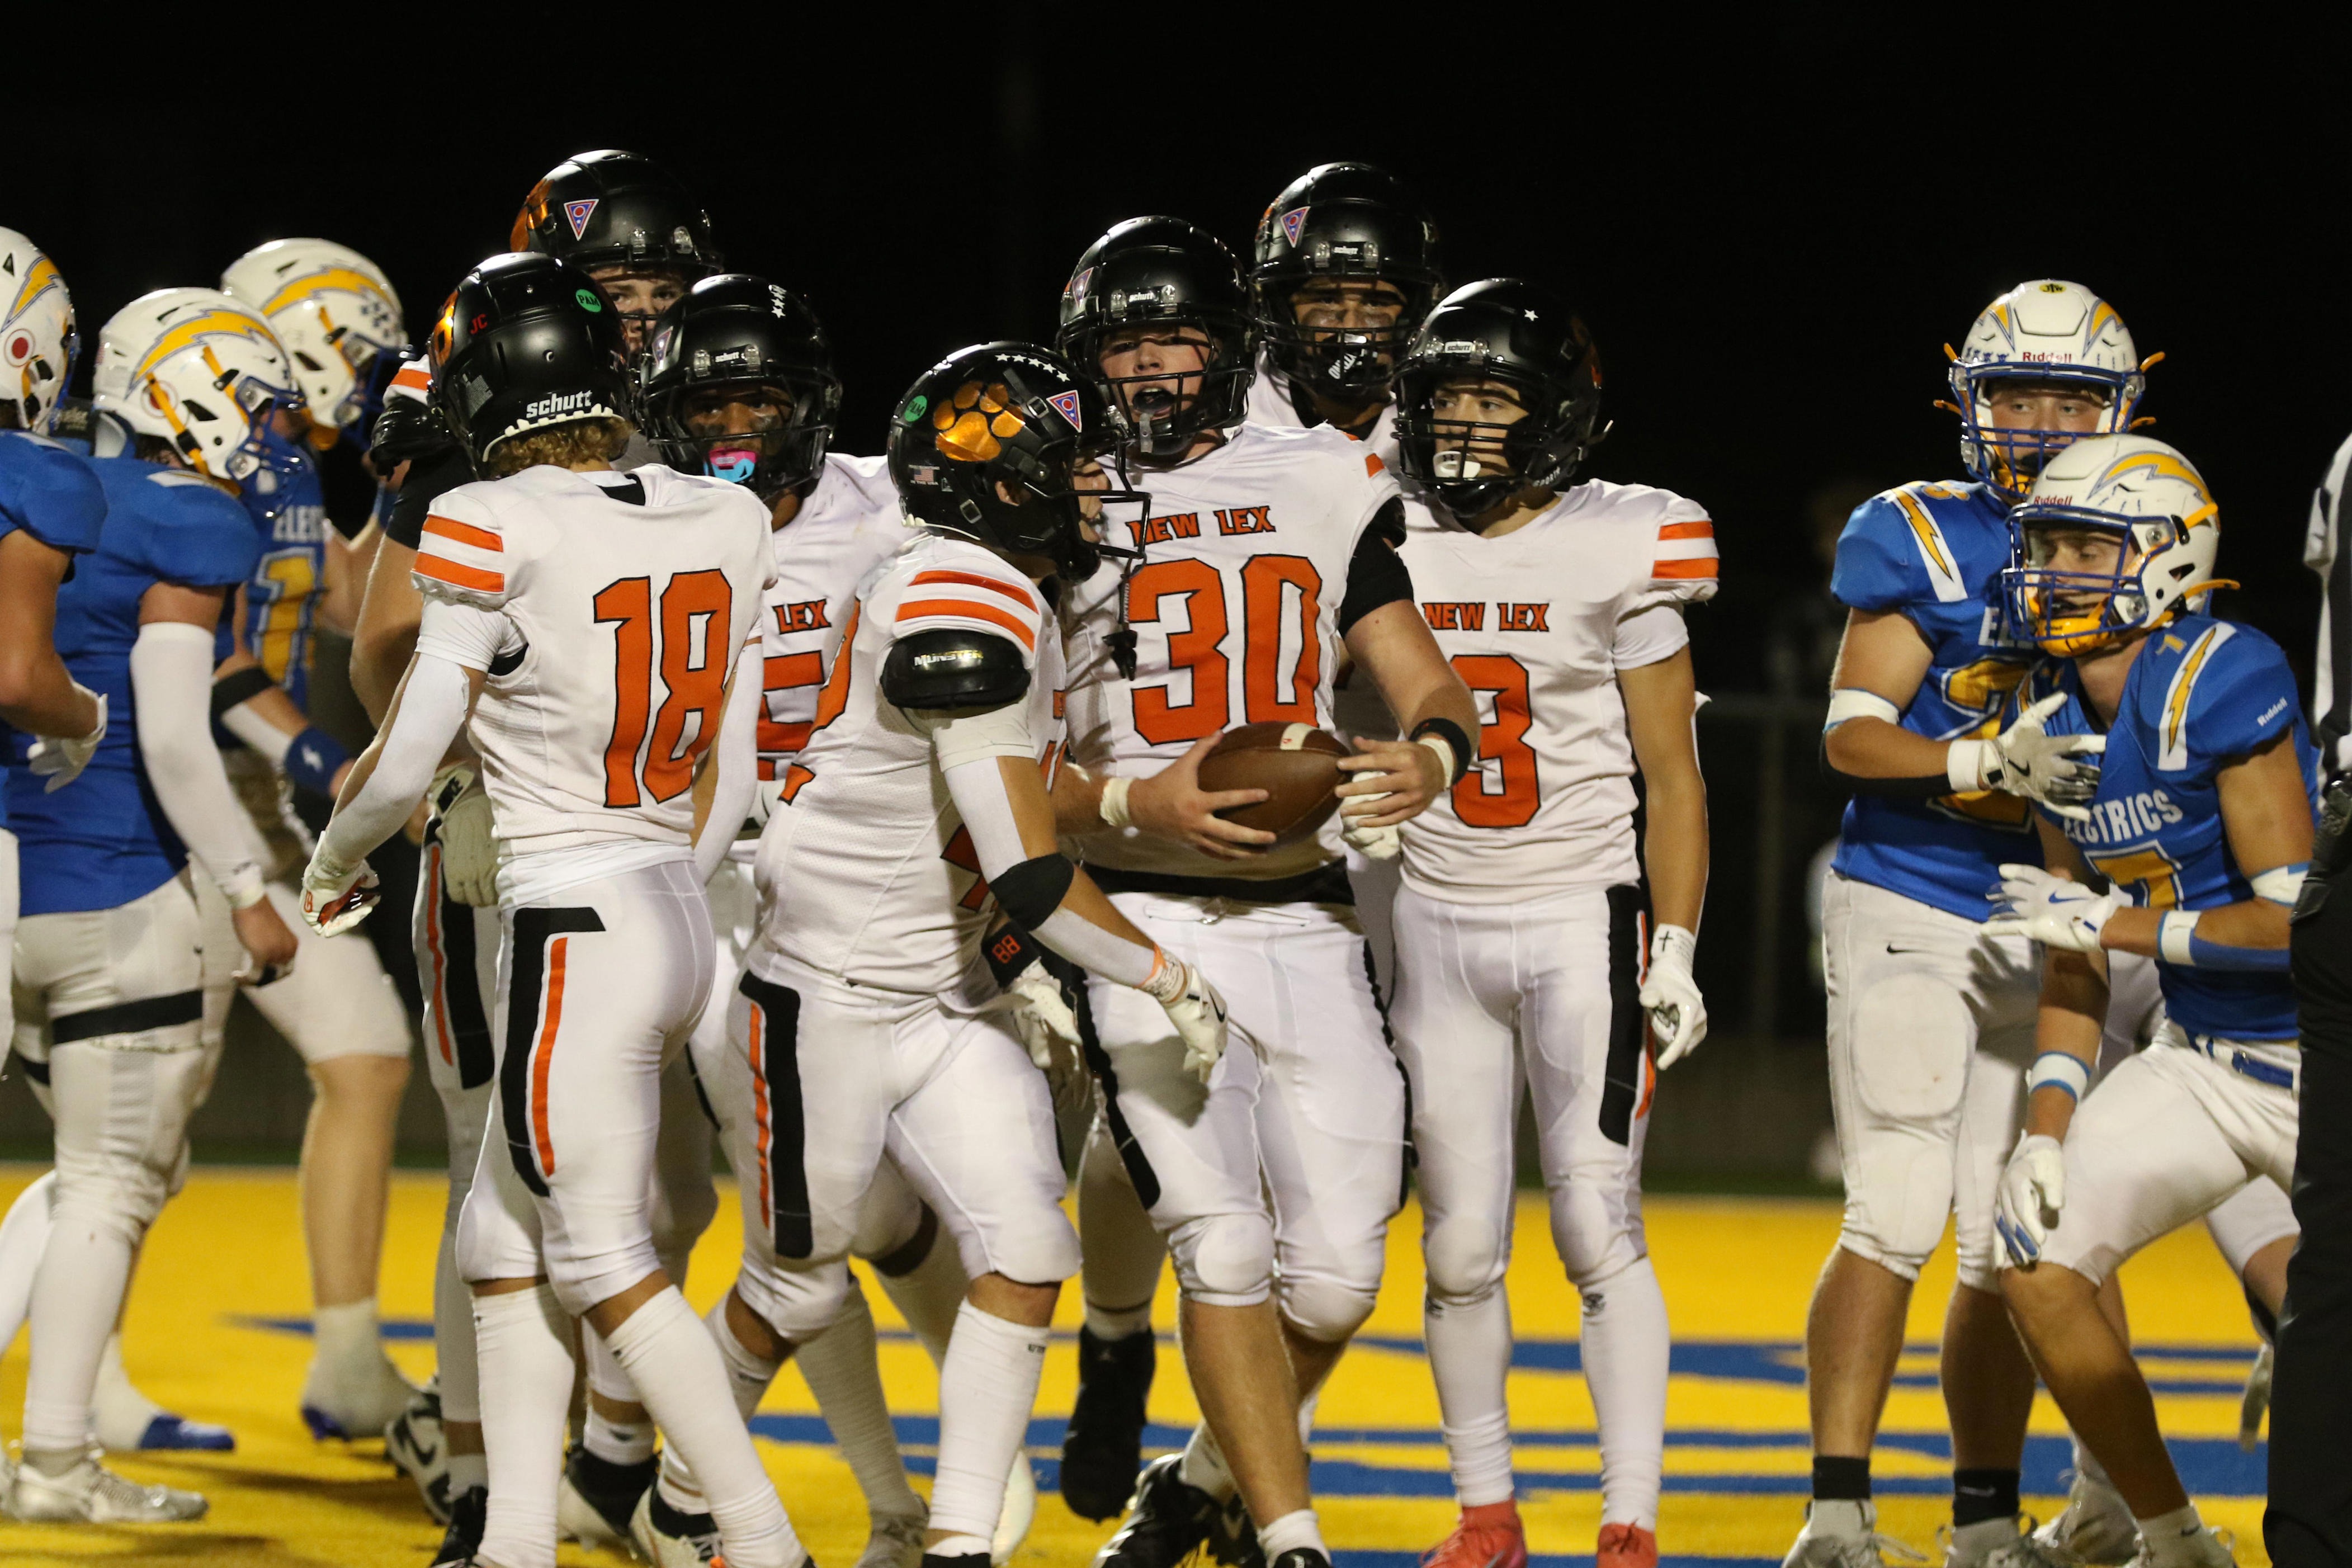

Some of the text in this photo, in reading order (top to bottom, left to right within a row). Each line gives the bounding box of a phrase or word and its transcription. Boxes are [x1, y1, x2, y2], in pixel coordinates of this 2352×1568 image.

[578, 295, 600, 306] PAM
[470, 314, 488, 334] JC
[2022, 352, 2072, 363] Riddell
[526, 390, 593, 419] schutt
[1125, 505, 1277, 547] NEW LEX
[772, 598, 832, 635] LEX
[1421, 602, 1550, 632] NEW LEX
[1128, 553, 1323, 747] 30
[593, 568, 732, 808] 18
[2257, 697, 2288, 726] Riddell
[1450, 654, 1541, 828] 3
